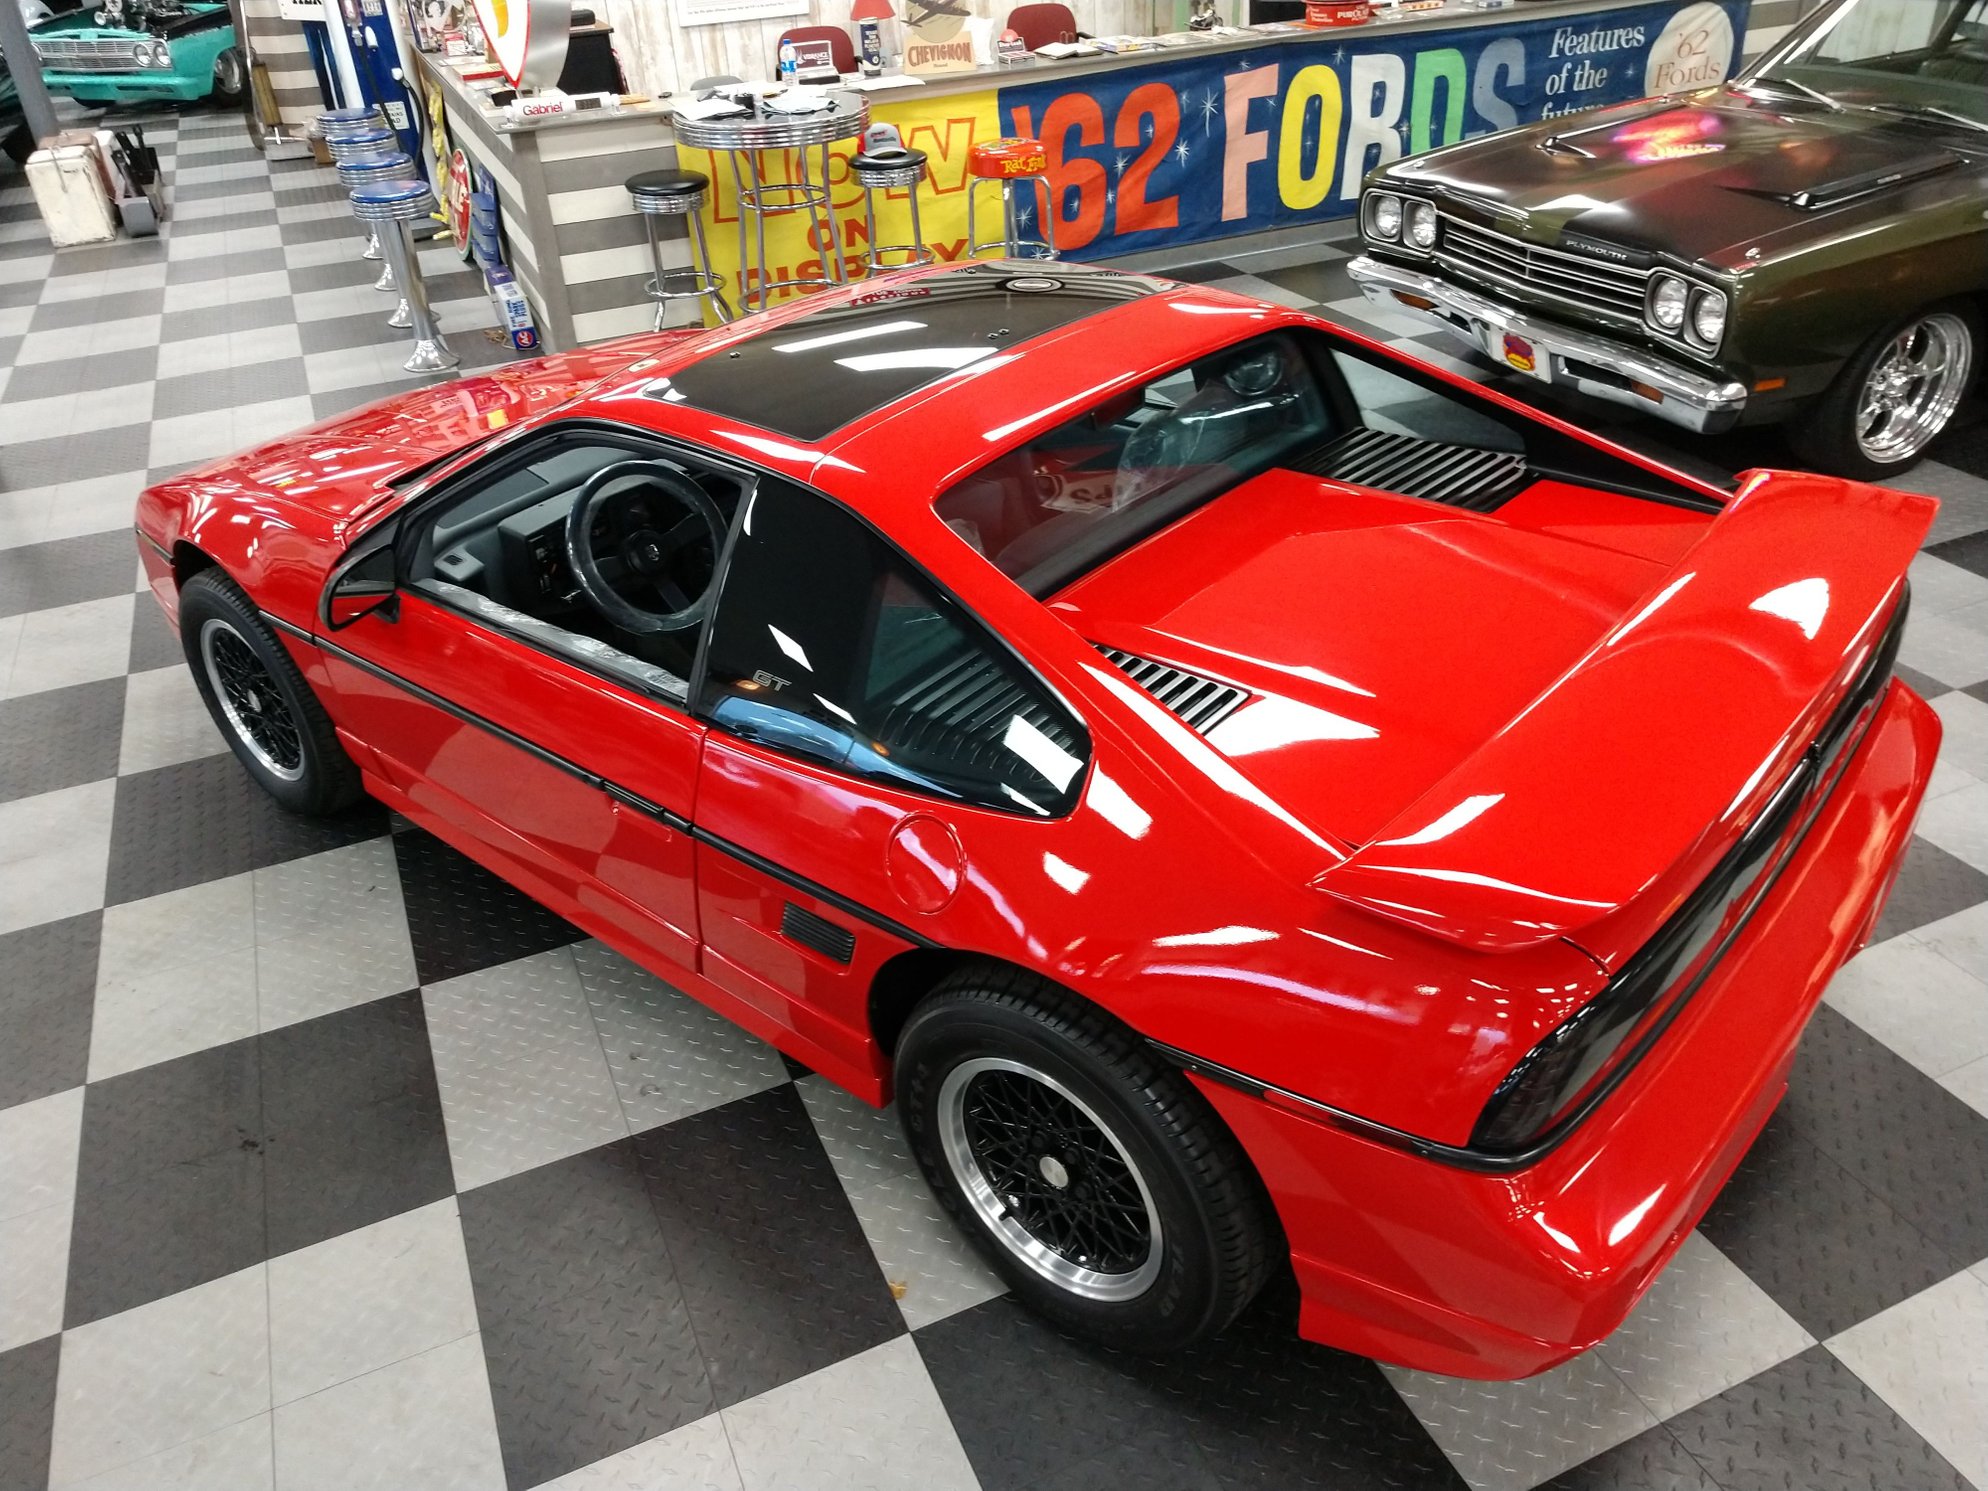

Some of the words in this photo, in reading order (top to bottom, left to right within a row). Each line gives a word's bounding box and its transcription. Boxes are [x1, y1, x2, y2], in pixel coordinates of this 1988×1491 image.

[908, 42, 971, 67] CHEVIGNON
[1548, 26, 1645, 58] Features
[1677, 29, 1709, 59] '62
[1545, 62, 1572, 95] of
[1573, 60, 1608, 92] the
[1655, 56, 1721, 88] Fords
[522, 102, 564, 116] Gabriel
[1011, 82, 1181, 250] '62
[1221, 38, 1526, 222] FORDS
[1001, 159, 1026, 173] Rat
[807, 214, 876, 252] ON
[1566, 240, 1627, 260] PLYMOUTH
[752, 669, 792, 691] GT
